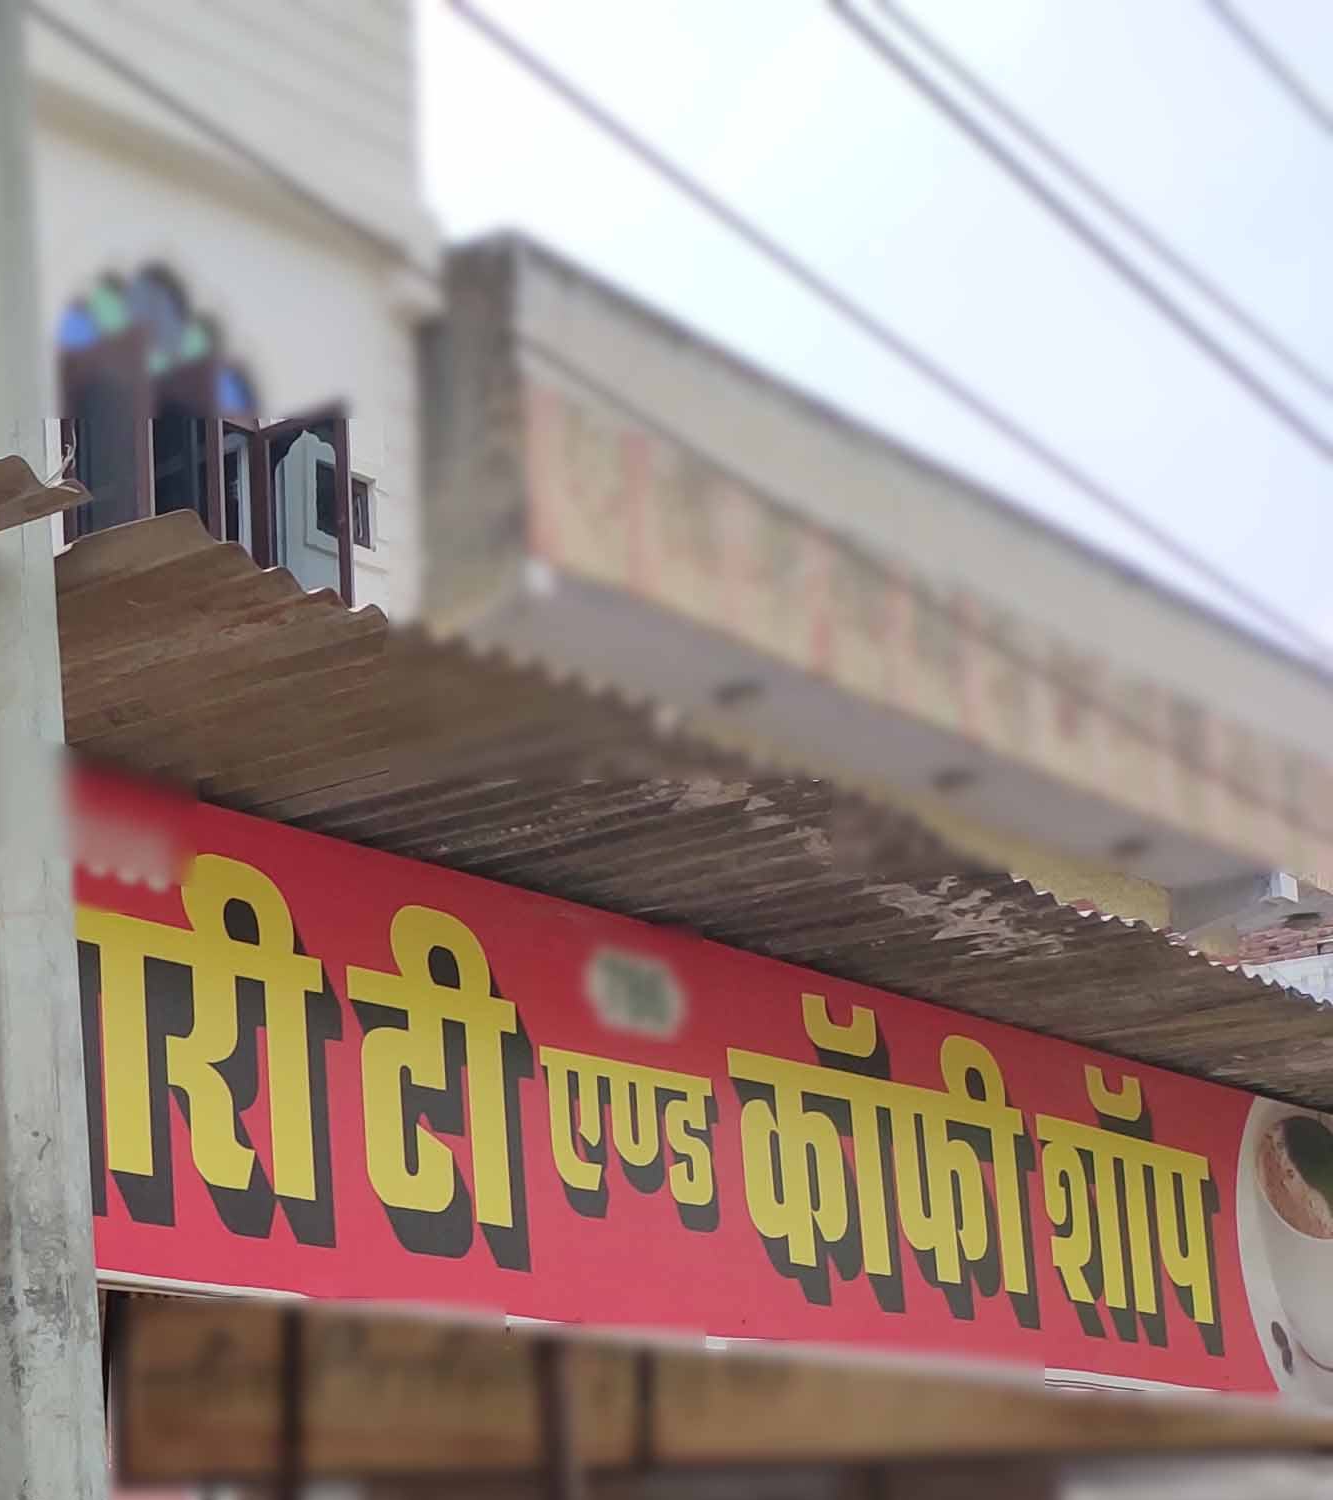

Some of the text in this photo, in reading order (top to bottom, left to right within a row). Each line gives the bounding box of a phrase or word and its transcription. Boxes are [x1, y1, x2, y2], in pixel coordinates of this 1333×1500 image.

[346, 905, 519, 1229] टी
[538, 1046, 713, 1206] एण्ड
[727, 993, 1030, 1295] कॉफी
[1036, 1066, 1217, 1326] शॉप
